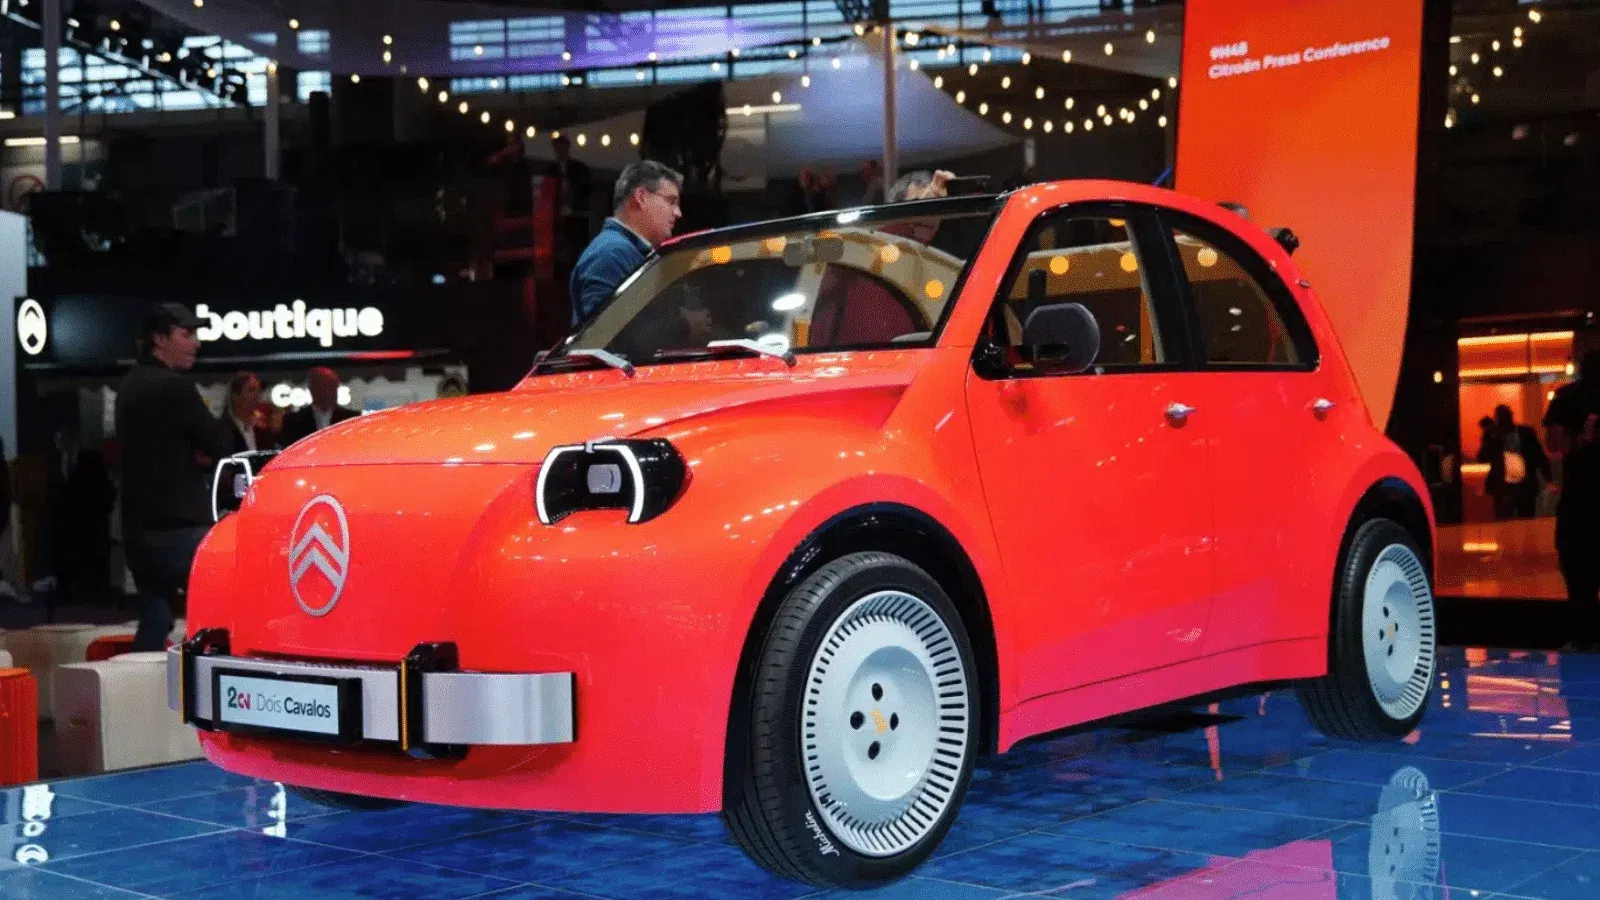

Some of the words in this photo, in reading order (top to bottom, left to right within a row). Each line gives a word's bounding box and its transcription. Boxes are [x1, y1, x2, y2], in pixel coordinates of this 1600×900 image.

[1262, 52, 1300, 69] Press
[1302, 36, 1390, 62] Conference
[196, 299, 384, 347] boutique
[284, 697, 331, 718] Cavalos
[804, 809, 840, 857] Michelin
